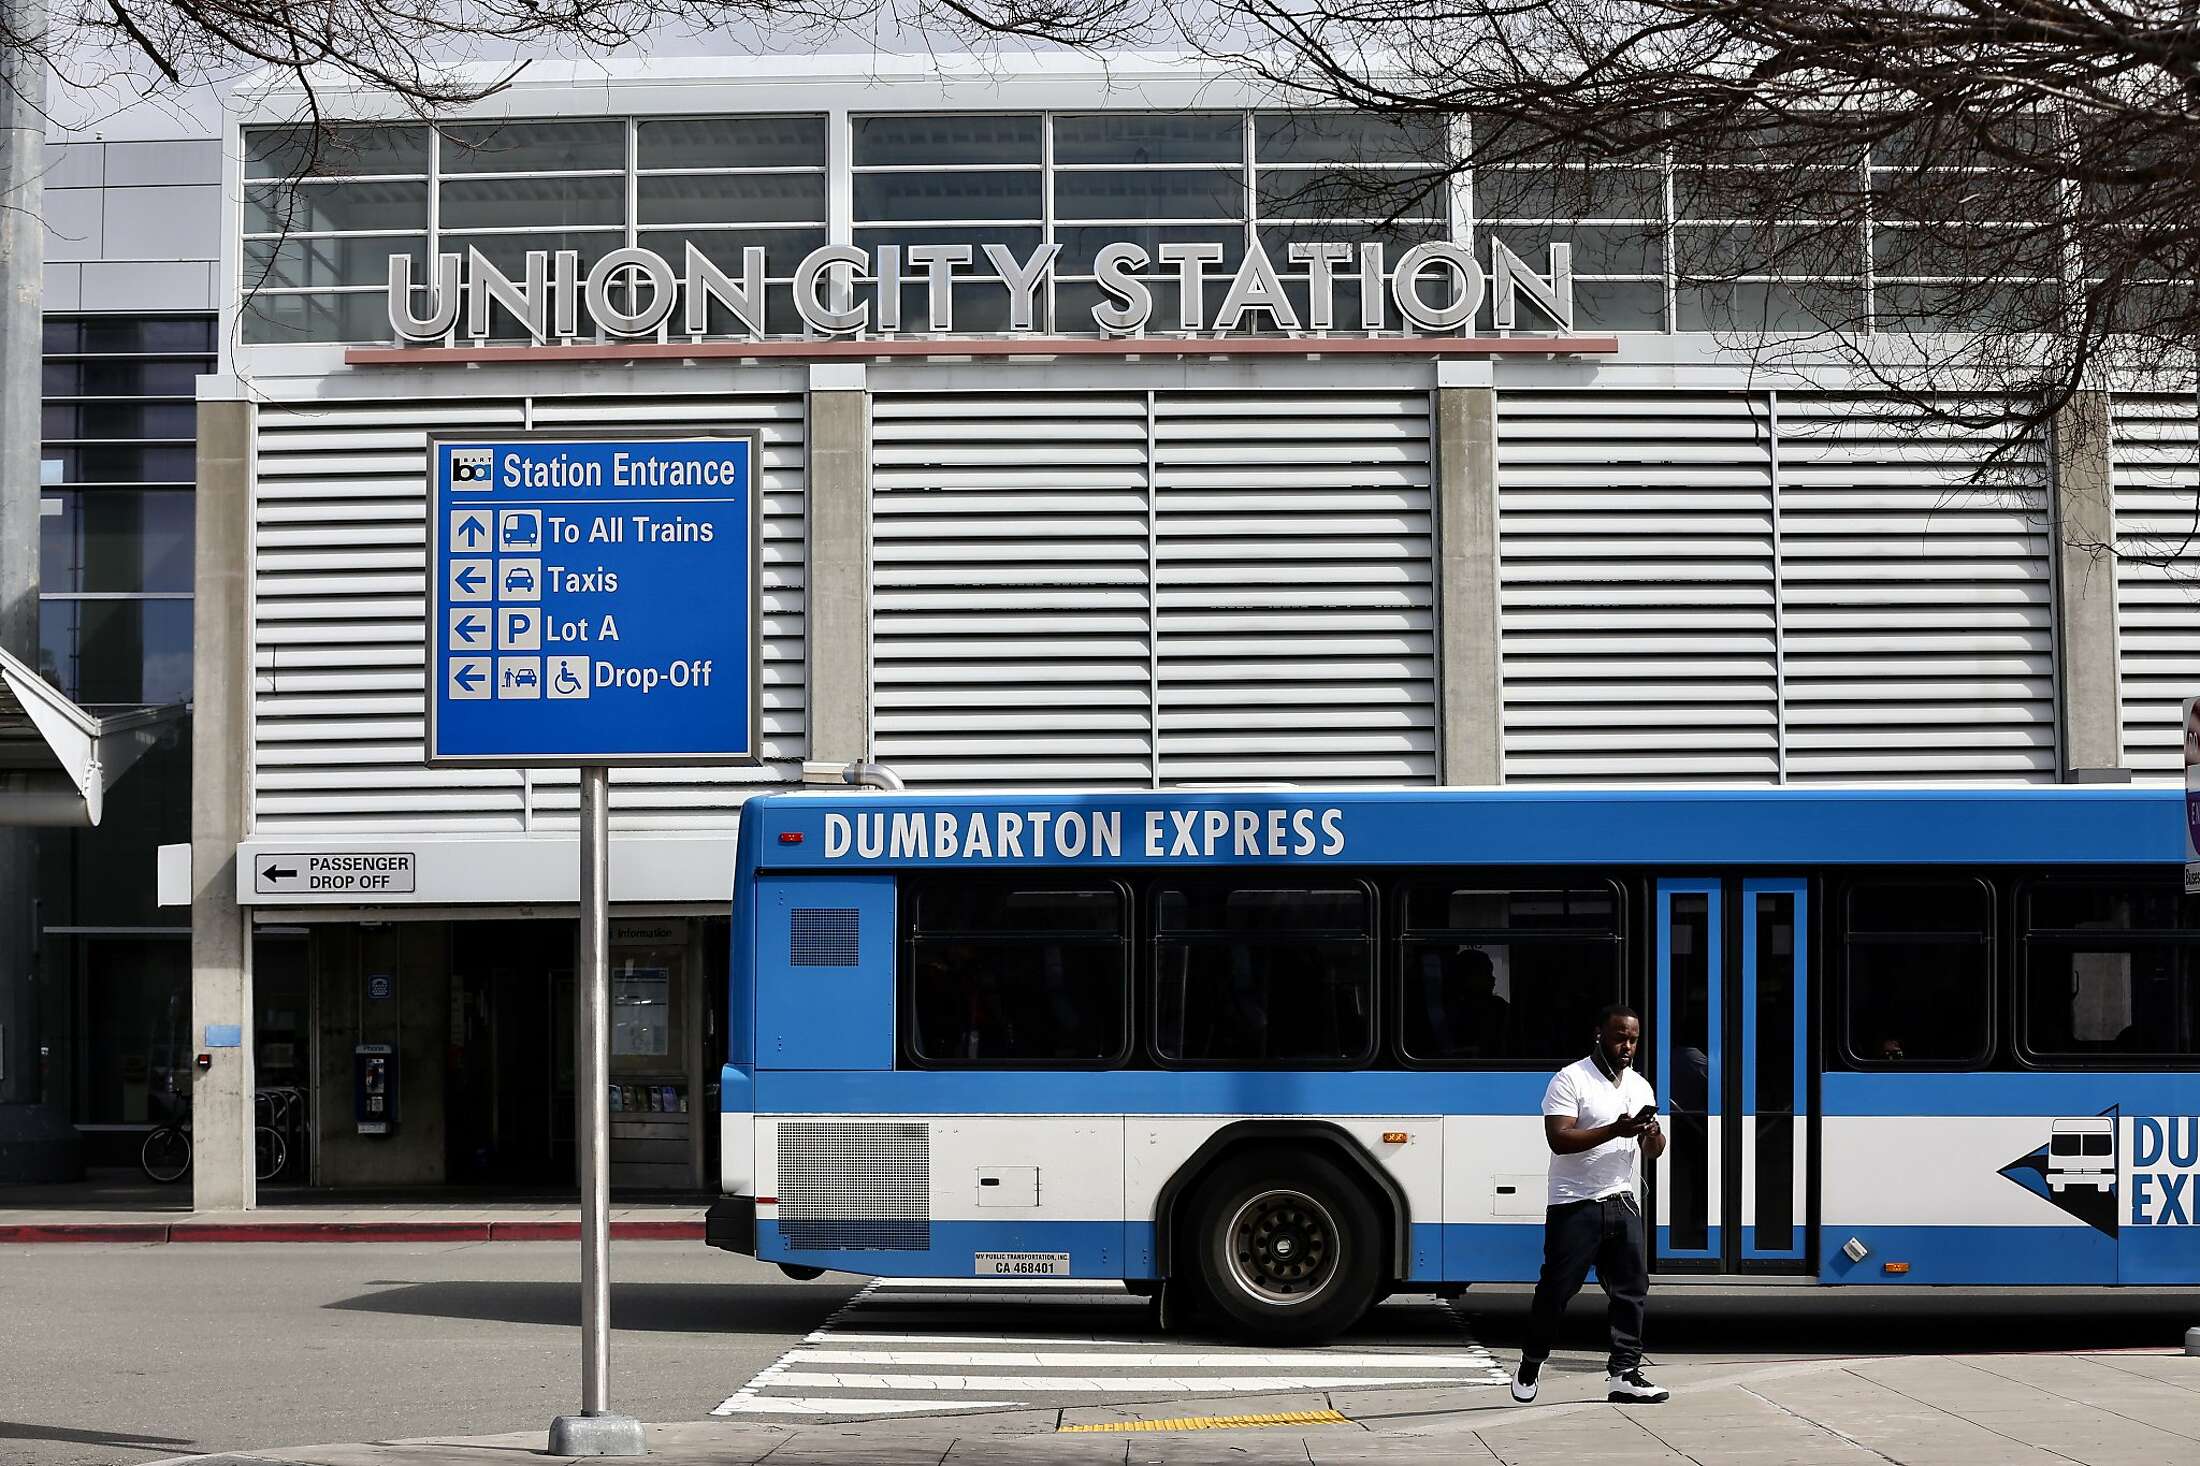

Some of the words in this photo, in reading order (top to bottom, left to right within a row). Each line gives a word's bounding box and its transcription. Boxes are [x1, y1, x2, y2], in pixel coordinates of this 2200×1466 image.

[388, 240, 765, 344] UNION
[793, 243, 1064, 334] CITY
[1091, 235, 1573, 337] STATION
[503, 453, 601, 488] Station
[613, 452, 735, 487] Entrance
[548, 517, 580, 544] To
[588, 517, 623, 543] All
[632, 516, 714, 543] Trains
[547, 566, 619, 593] Taxis
[547, 615, 589, 642] Lot
[598, 614, 620, 641] A
[594, 659, 712, 694] Drop-Off
[824, 810, 1122, 859] DUMBARTON
[1144, 808, 1346, 857] EXPRESS
[309, 857, 409, 871] PASSENGER
[309, 875, 355, 889] DROP
[359, 875, 390, 889] OFF
[617, 926, 673, 938] Information
[995, 1262, 1011, 1274] CA
[1013, 1262, 1055, 1274] 468401
